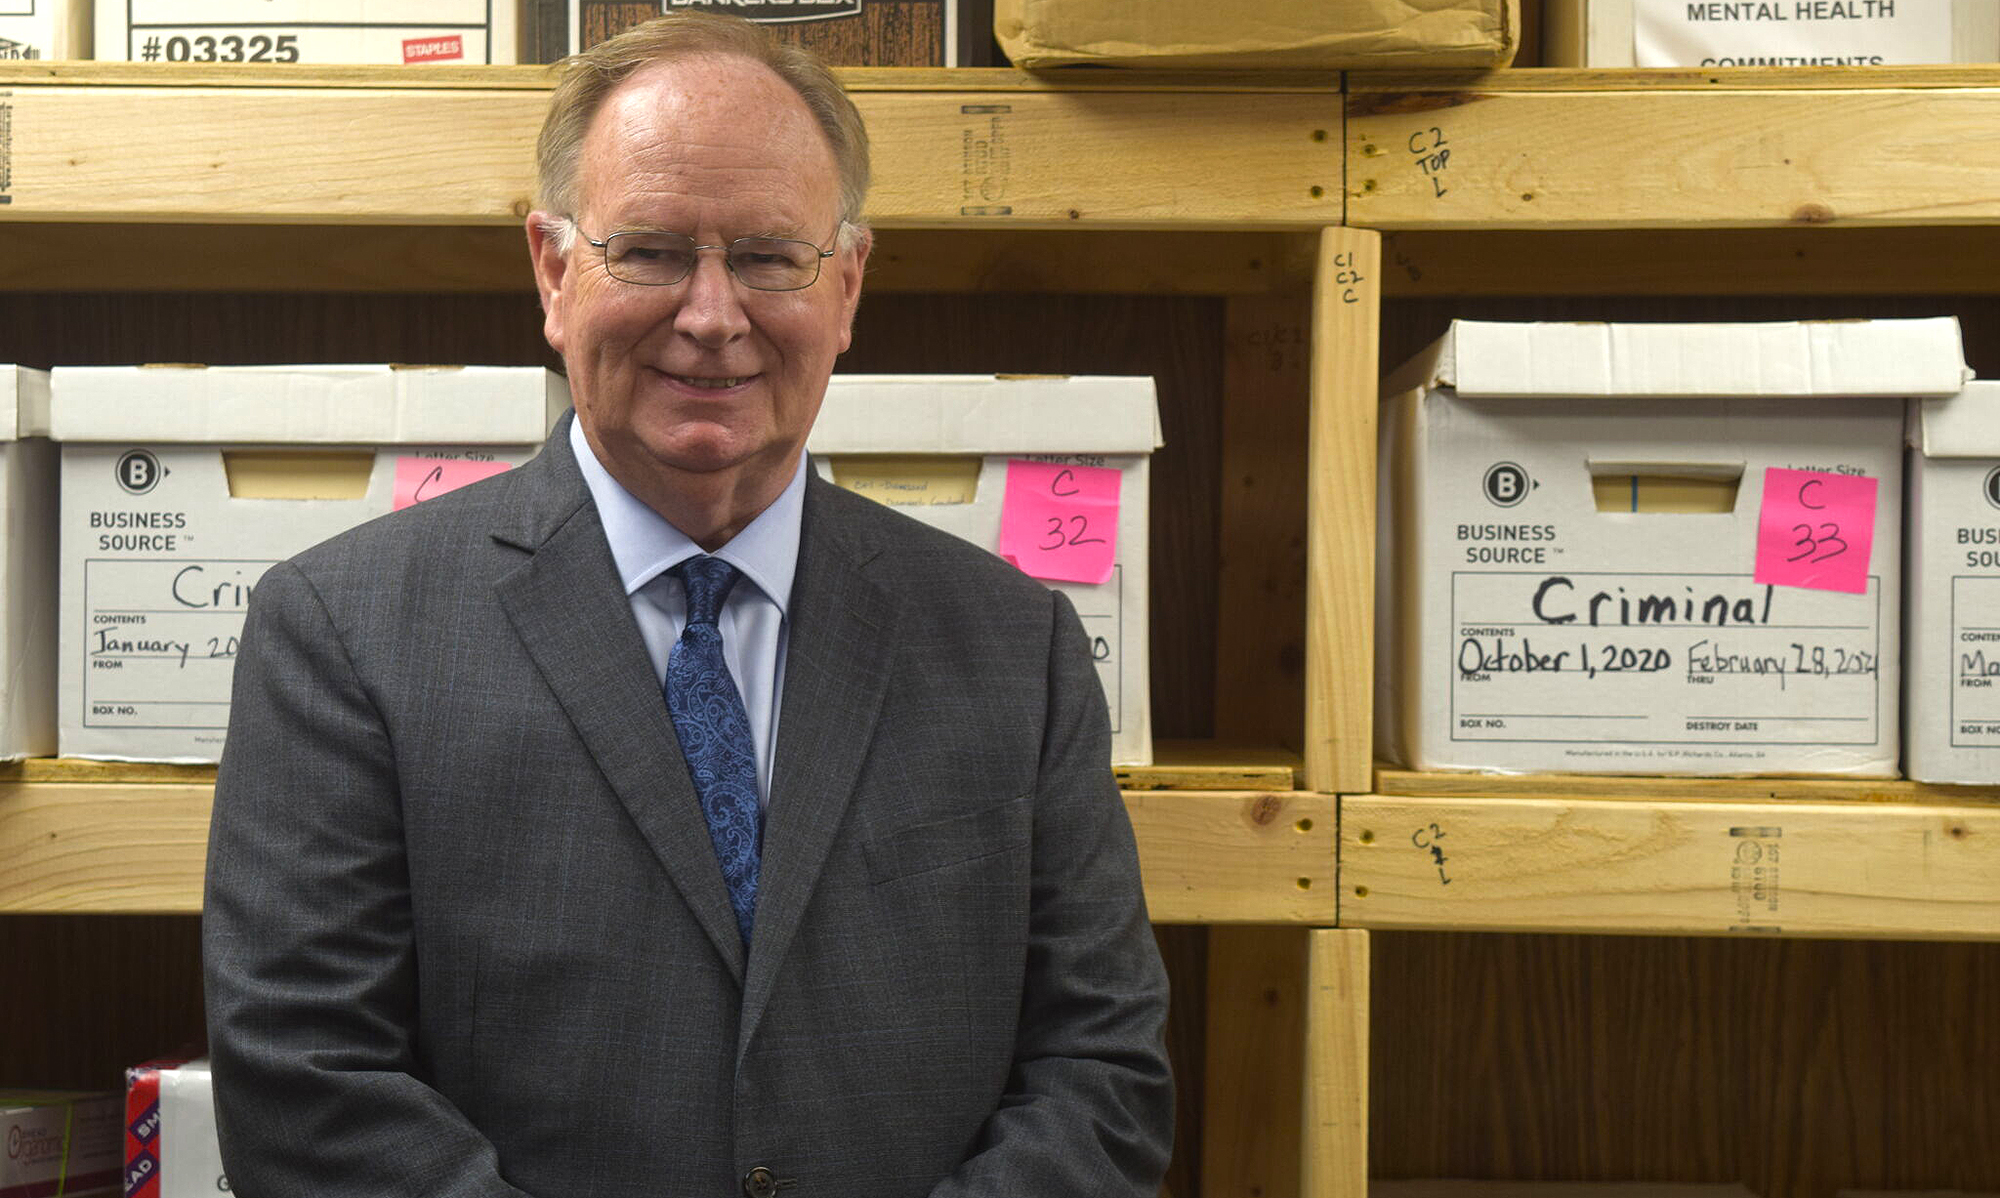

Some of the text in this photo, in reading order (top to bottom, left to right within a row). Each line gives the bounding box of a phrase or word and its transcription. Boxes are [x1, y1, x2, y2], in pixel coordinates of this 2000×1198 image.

[1687, 0, 1895, 21] MENTAL HEALTH
[142, 36, 299, 62] #03325
[406, 41, 459, 58] STAPLES
[1416, 149, 1450, 175] TOP
[1334, 252, 1352, 267] C1
[1336, 270, 1364, 284] C2
[1343, 289, 1359, 303] C
[1052, 470, 1079, 496] C
[1799, 480, 1826, 509] C
[90, 512, 186, 528] BUSINESS
[1039, 515, 1105, 550] 32
[1457, 524, 1556, 541] BUSINESS
[99, 535, 177, 551] SOURCE
[1787, 523, 1848, 563] 33
[1466, 547, 1546, 563] SOURCE
[173, 565, 251, 608] Cri
[1532, 576, 1774, 626] Criminal
[94, 615, 146, 624] CONTENTS
[1461, 628, 1515, 637] CONTENTS
[91, 627, 189, 669] January
[1459, 638, 1570, 674] October
[93, 661, 123, 670] FROM
[1687, 640, 1786, 691] February
[1461, 673, 1491, 682] FROM
[1687, 675, 1714, 684] THRU
[1961, 679, 1992, 688] FROM
[93, 706, 138, 716] BOX NO.
[1460, 719, 1507, 729] BOX NO.
[1686, 721, 1758, 731] DESTROY DATE
[1961, 726, 1981, 735] BOX
